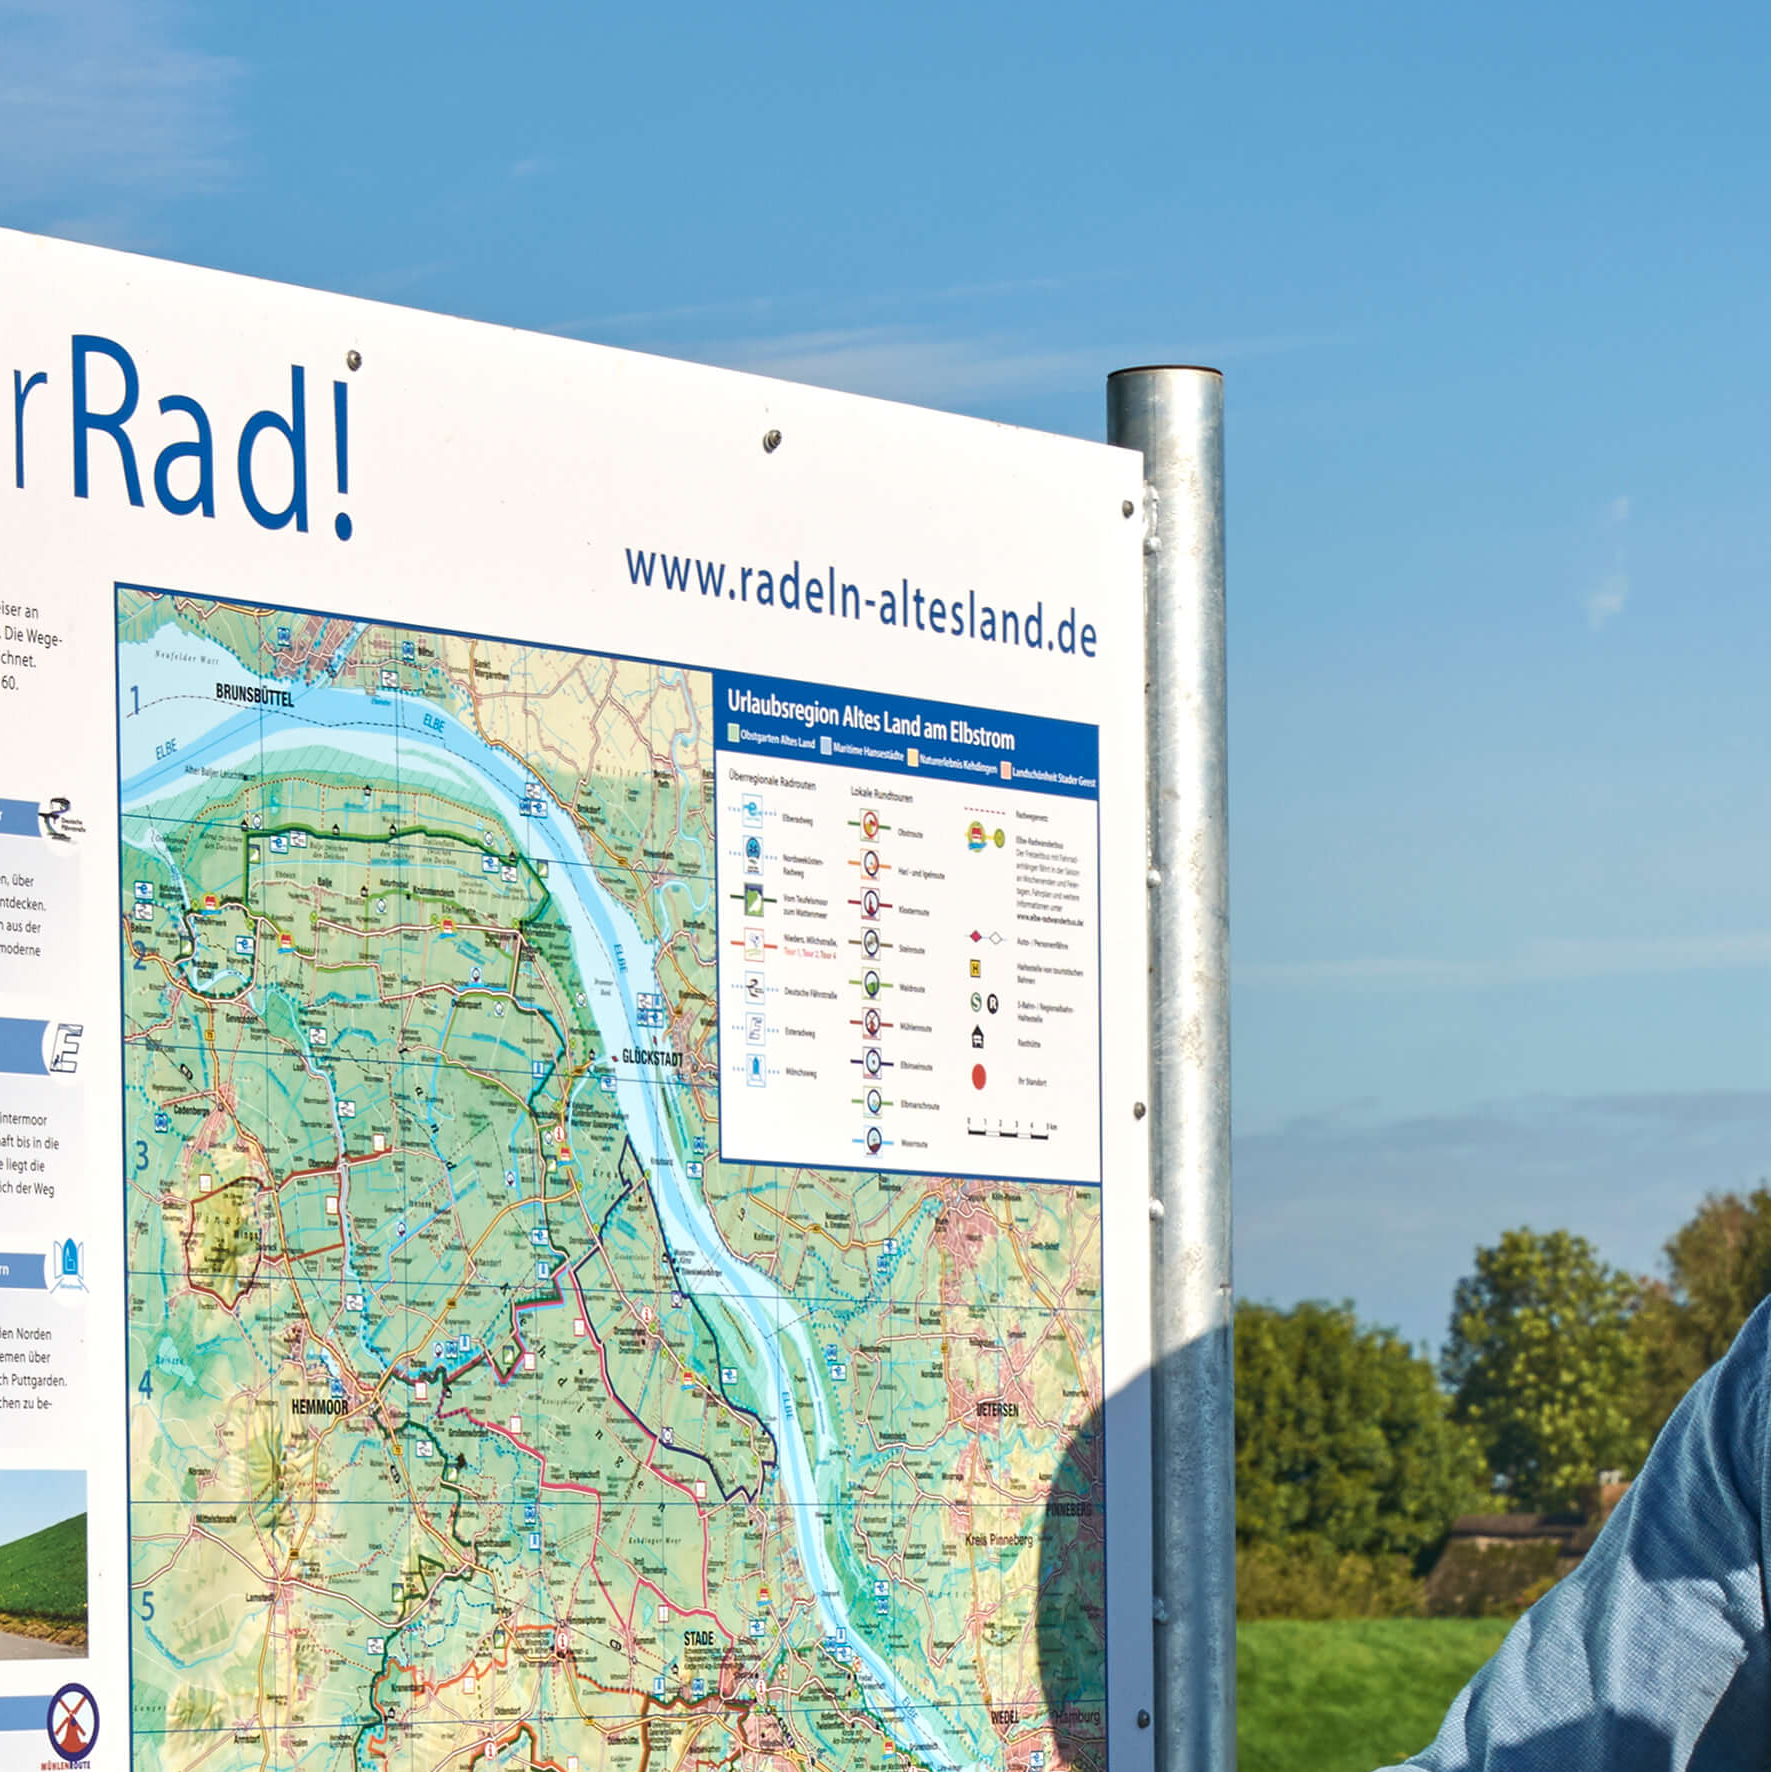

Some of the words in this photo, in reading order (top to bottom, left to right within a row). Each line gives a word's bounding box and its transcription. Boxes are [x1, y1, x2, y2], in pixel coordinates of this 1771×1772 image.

[625, 547, 1097, 658] www.radeln-altesland.de
[25, 607, 39, 619] an
[215, 682, 295, 709] BRUNSBÜTTEL
[423, 713, 446, 734] ELBE
[727, 688, 840, 728] Urlaubsregion
[842, 705, 881, 732] Altes
[883, 711, 921, 737] Land
[923, 722, 948, 741] am
[950, 720, 1015, 751] Elbstrom
[621, 1045, 684, 1068] GLÜCKSTADT
[137, 1370, 154, 1400] 4
[291, 1399, 349, 1416] HEMMOOR
[976, 1403, 1020, 1420] UETERSEN
[965, 1533, 988, 1547] Kreis
[990, 1533, 1034, 1549] Pinneberg
[684, 1631, 715, 1647] STADE
[991, 1710, 1020, 1725] WEDEL
